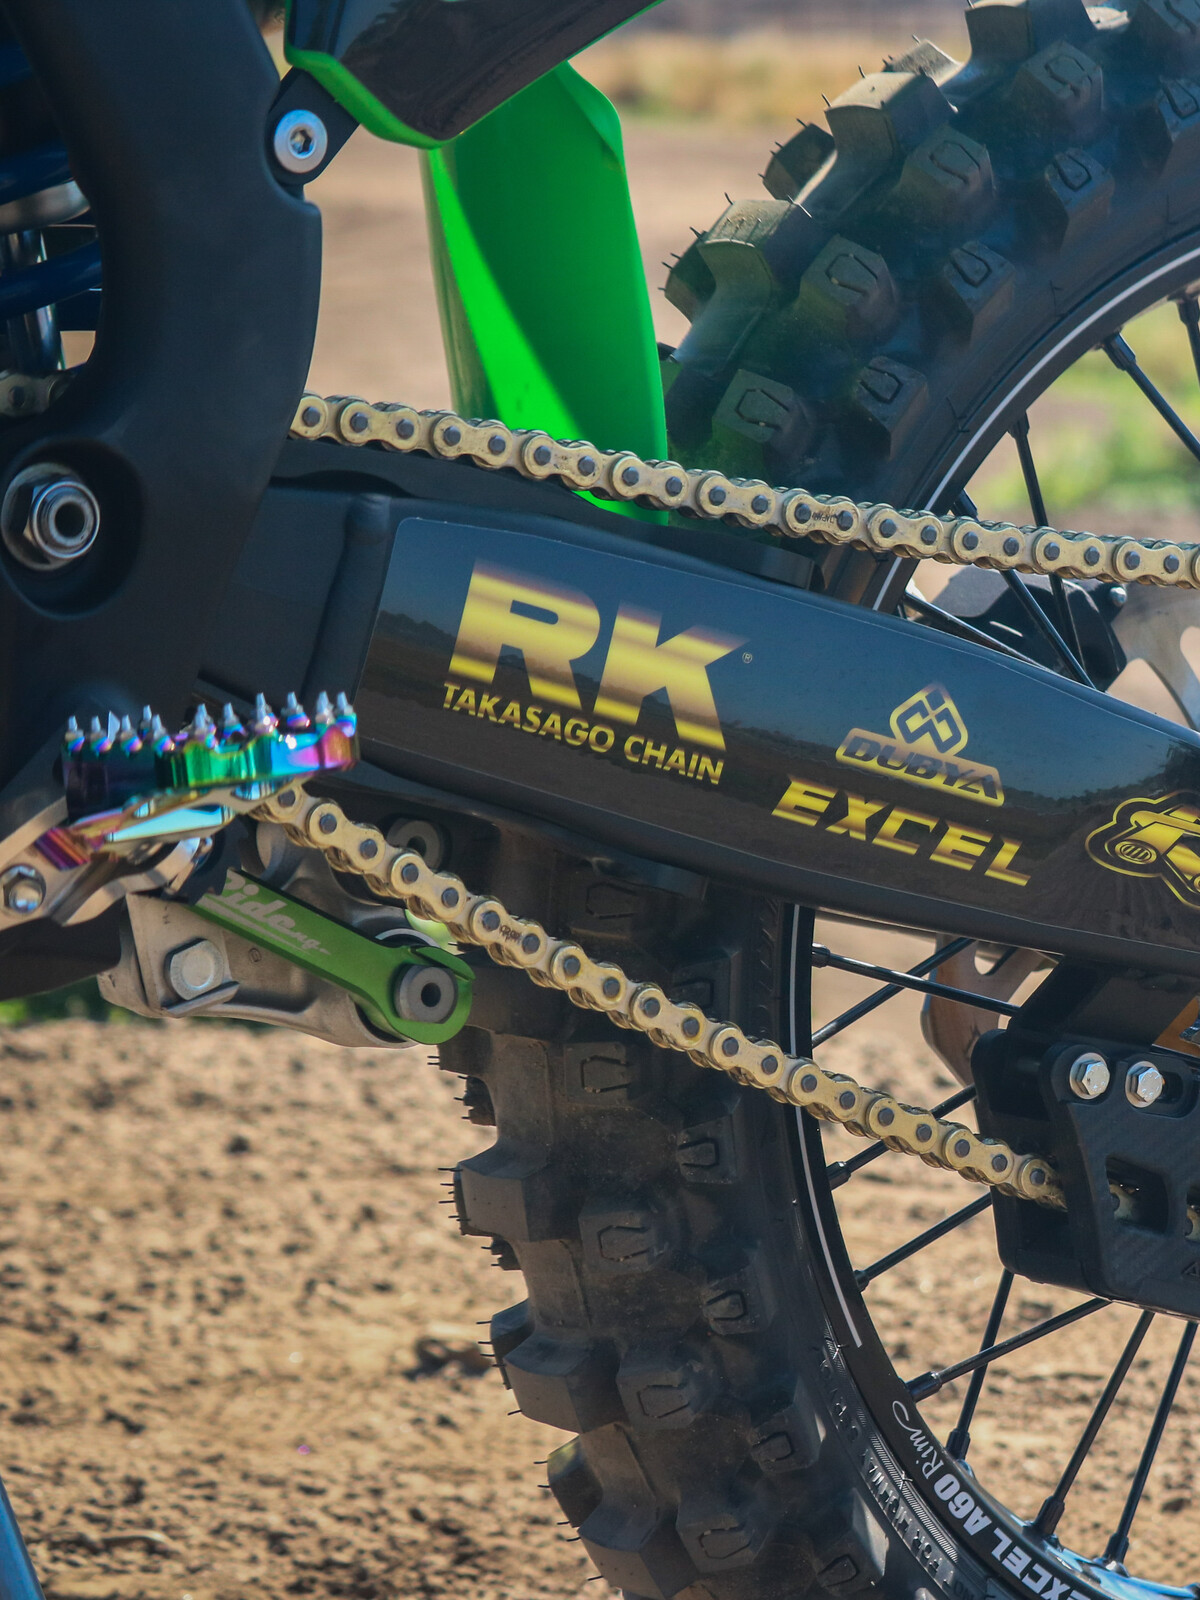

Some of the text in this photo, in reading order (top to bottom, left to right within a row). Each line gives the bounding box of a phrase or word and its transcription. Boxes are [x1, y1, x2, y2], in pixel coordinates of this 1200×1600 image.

[449, 557, 750, 752] RK
[442, 681, 725, 785] TAKASAGO CHAIN
[841, 734, 999, 801] DUBYA
[771, 773, 1032, 887] EXCEL
[933, 1472, 993, 1537] A60
